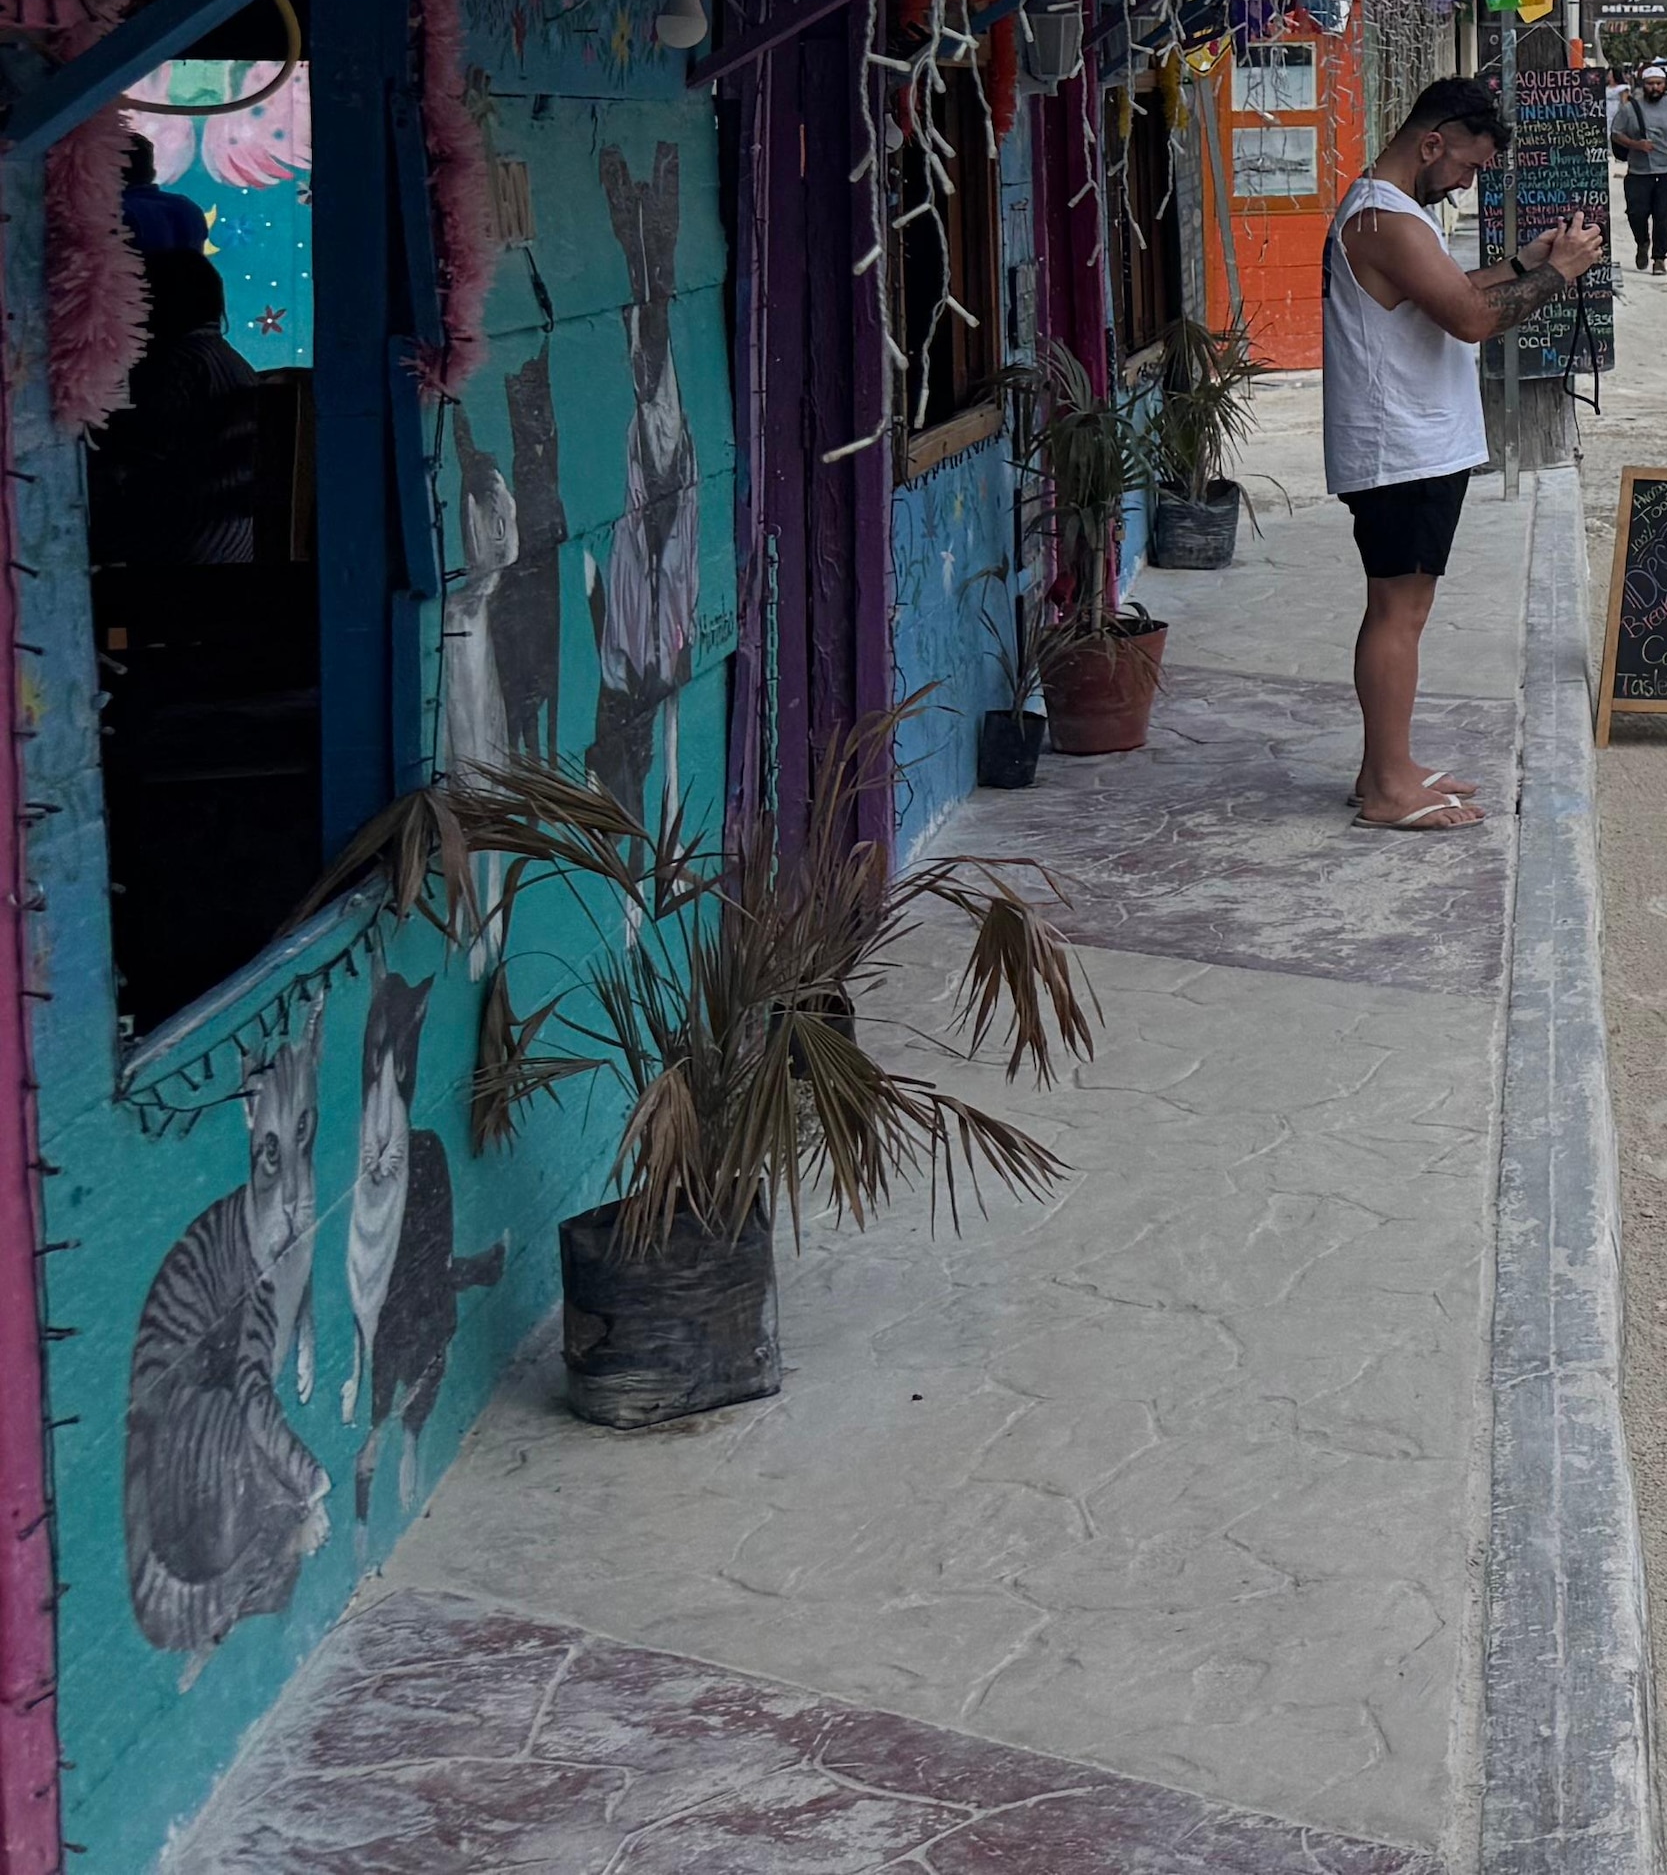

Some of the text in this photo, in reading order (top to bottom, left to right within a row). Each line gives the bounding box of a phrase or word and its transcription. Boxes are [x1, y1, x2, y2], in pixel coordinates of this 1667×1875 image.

[1515, 69, 1581, 89] AQUETES
[1516, 87, 1594, 106] SAYUNOS
[1520, 103, 1585, 120] INENTAL
